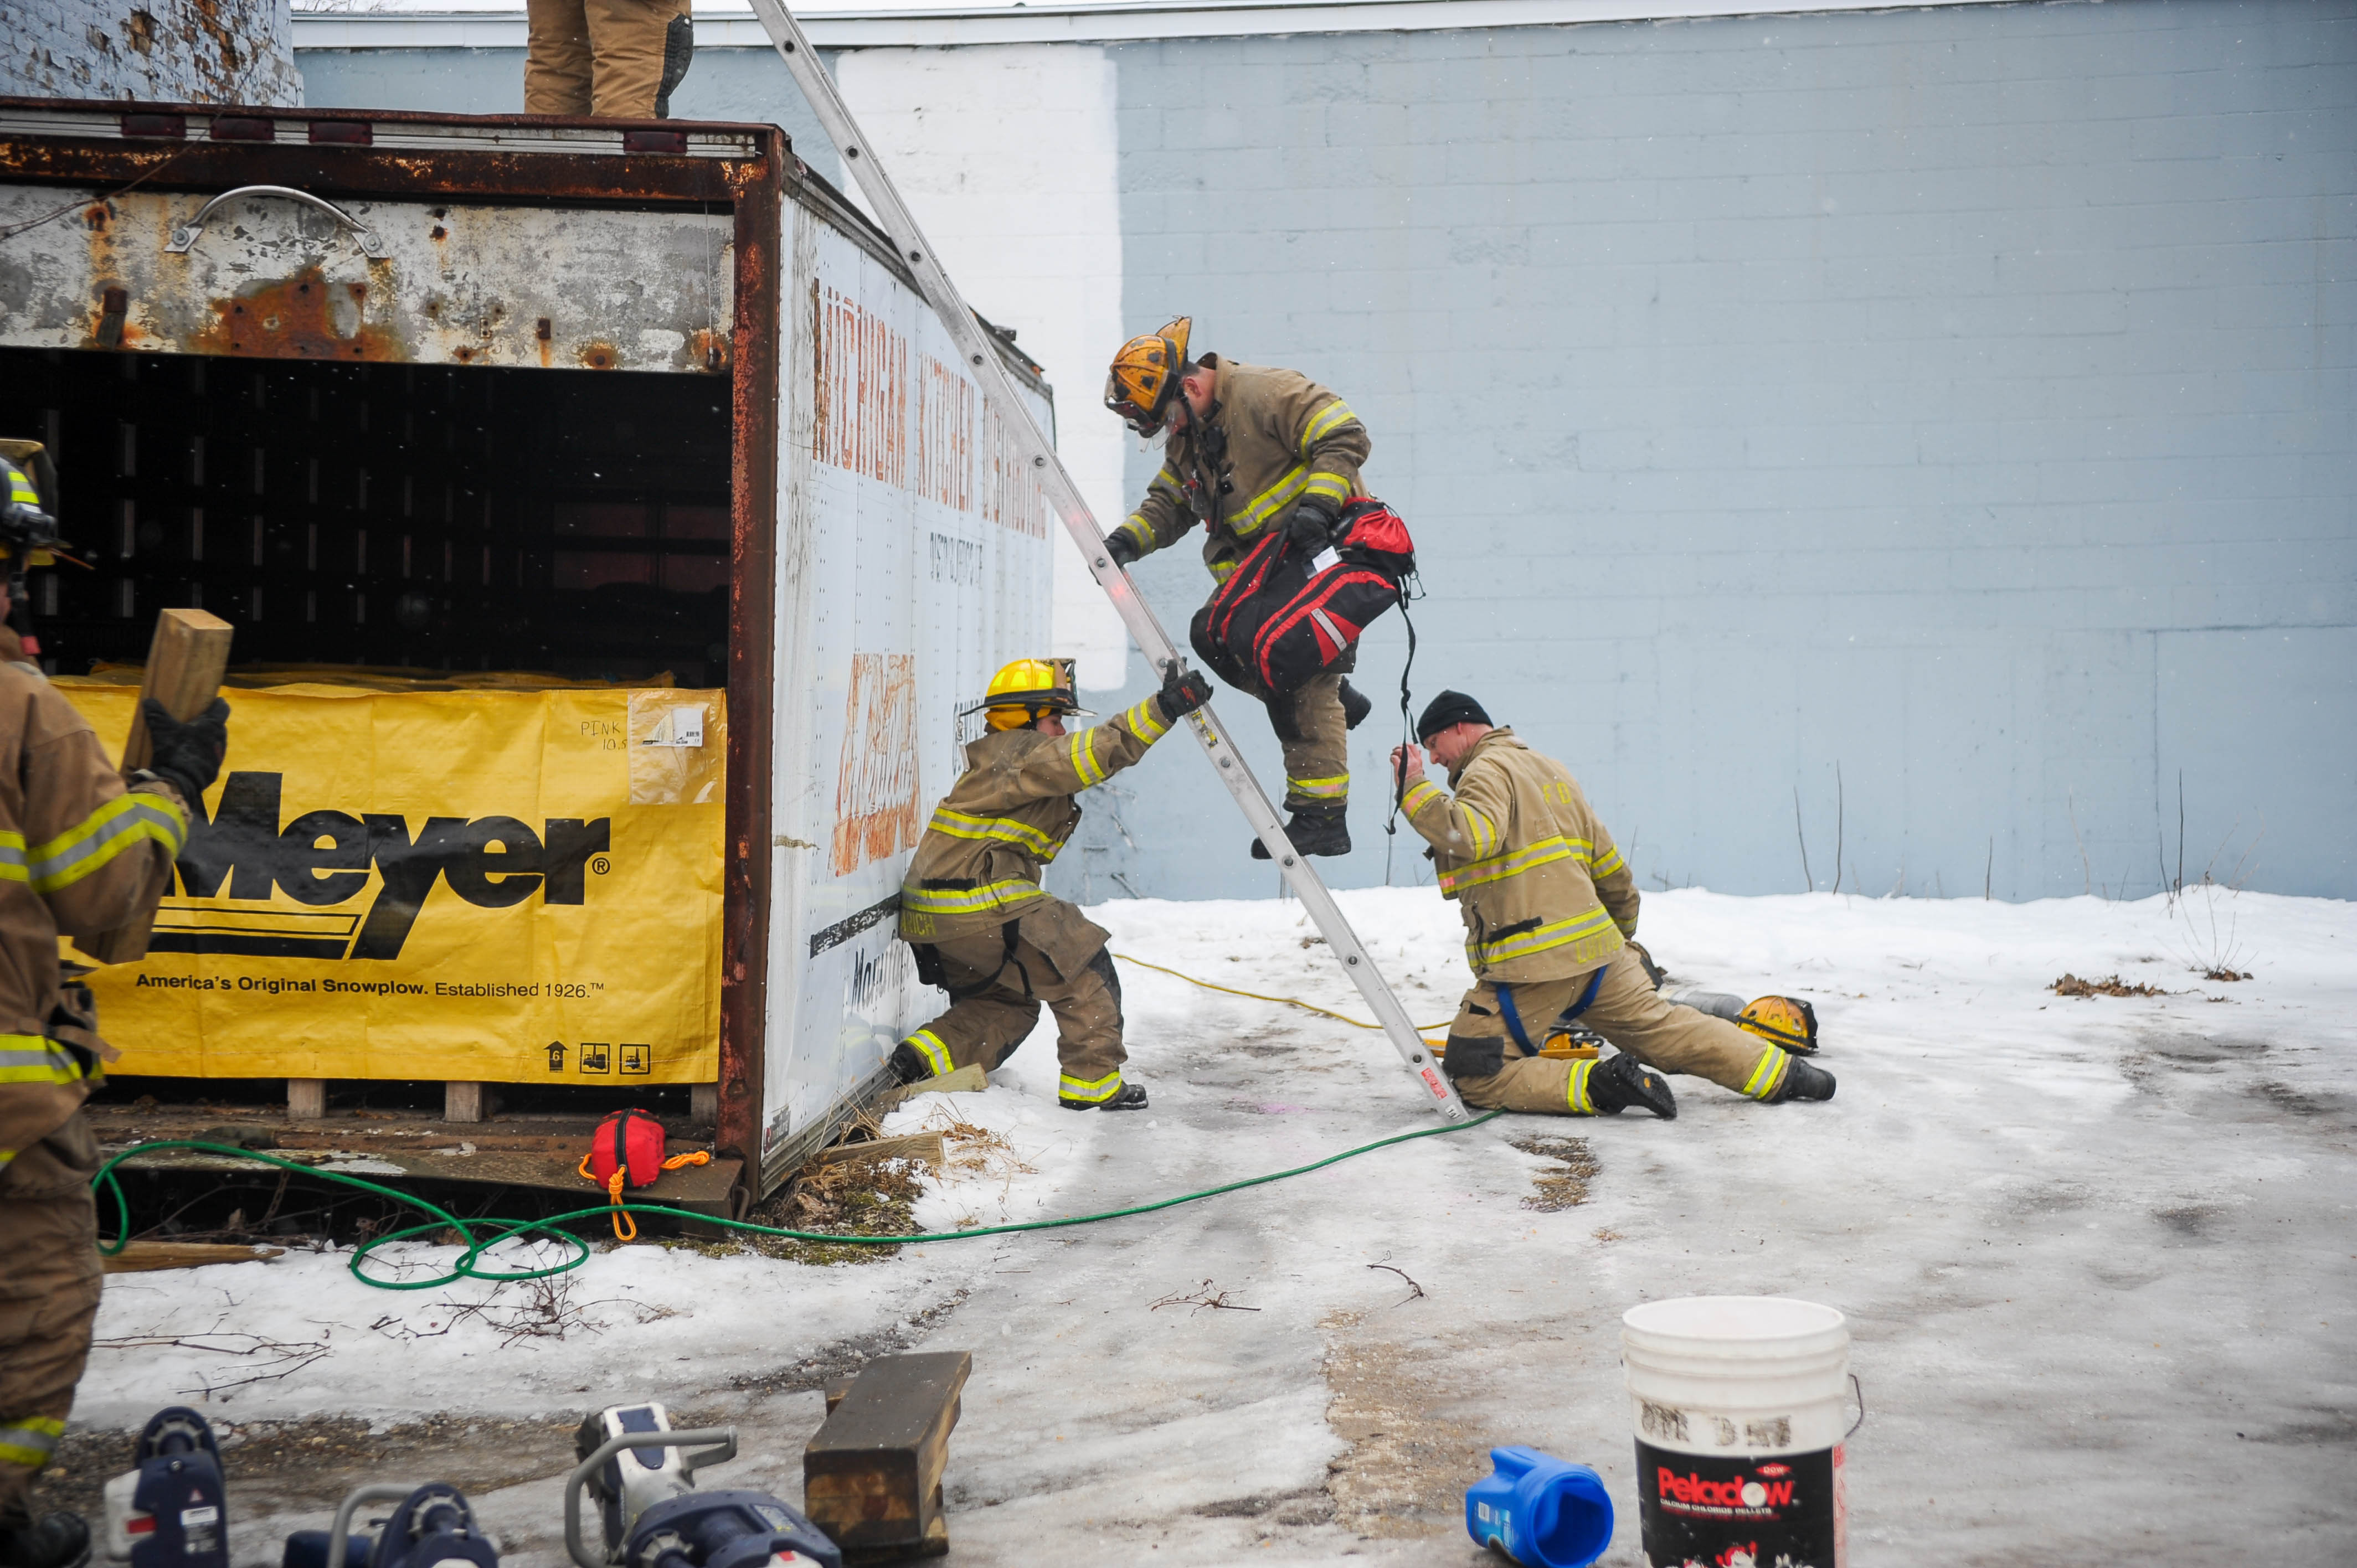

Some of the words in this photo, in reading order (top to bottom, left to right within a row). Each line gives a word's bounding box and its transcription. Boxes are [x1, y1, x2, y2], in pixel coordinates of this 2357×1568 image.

[813, 277, 907, 492] MICHIGAN
[917, 351, 974, 513] KITCHEN
[581, 721, 621, 736] PINK
[136, 973, 232, 991] America’s
[238, 977, 316, 995] Original
[322, 978, 429, 996] Snowplow.
[435, 982, 539, 997] Established
[552, 1050, 560, 1061] 6
[1763, 1466, 1784, 1474] DOW
[1660, 1498, 1690, 1510] CALCIUM
[1692, 1505, 1733, 1514] CHLORIDE
[1735, 1507, 1772, 1515] PELLETS
